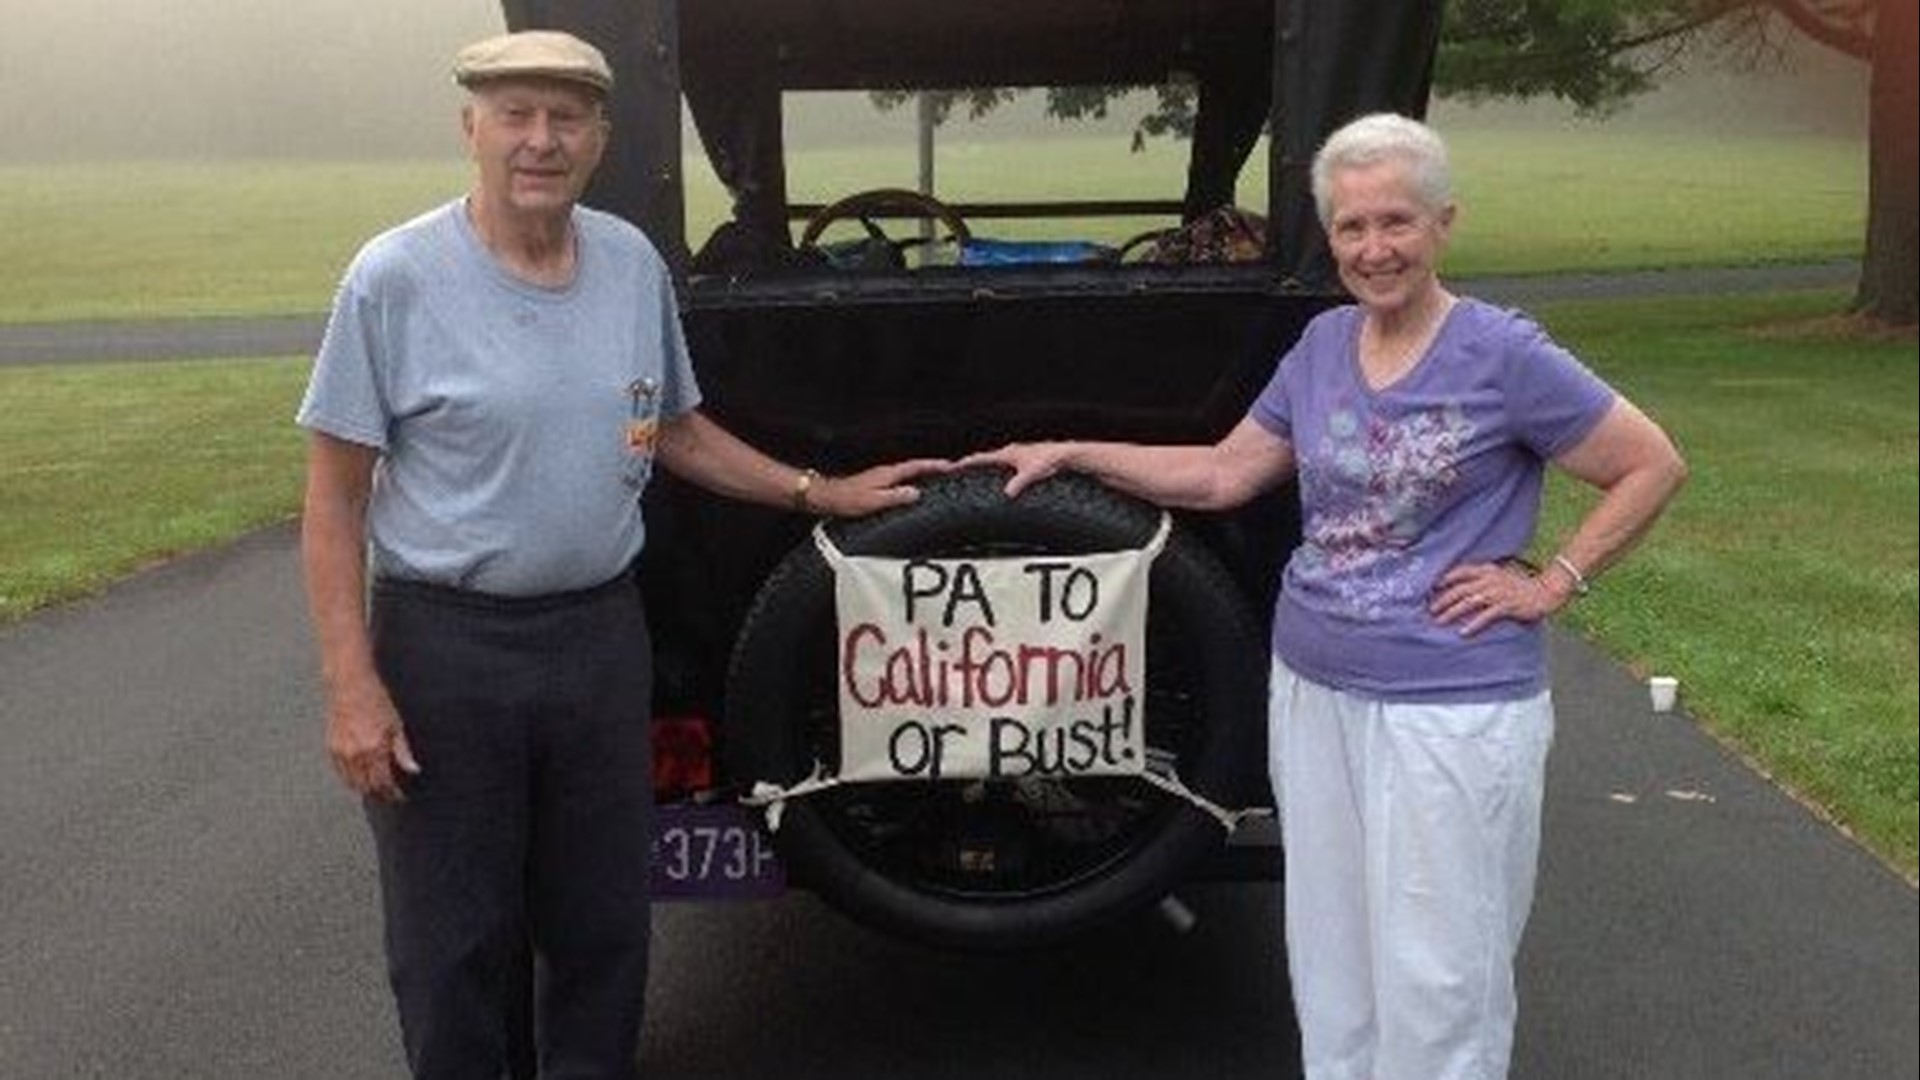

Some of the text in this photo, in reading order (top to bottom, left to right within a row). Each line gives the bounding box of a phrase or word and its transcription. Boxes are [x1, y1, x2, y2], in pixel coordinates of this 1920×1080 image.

[904, 560, 1098, 627] PA TO
[844, 622, 1131, 708] California
[888, 695, 1135, 778] or Bust!
